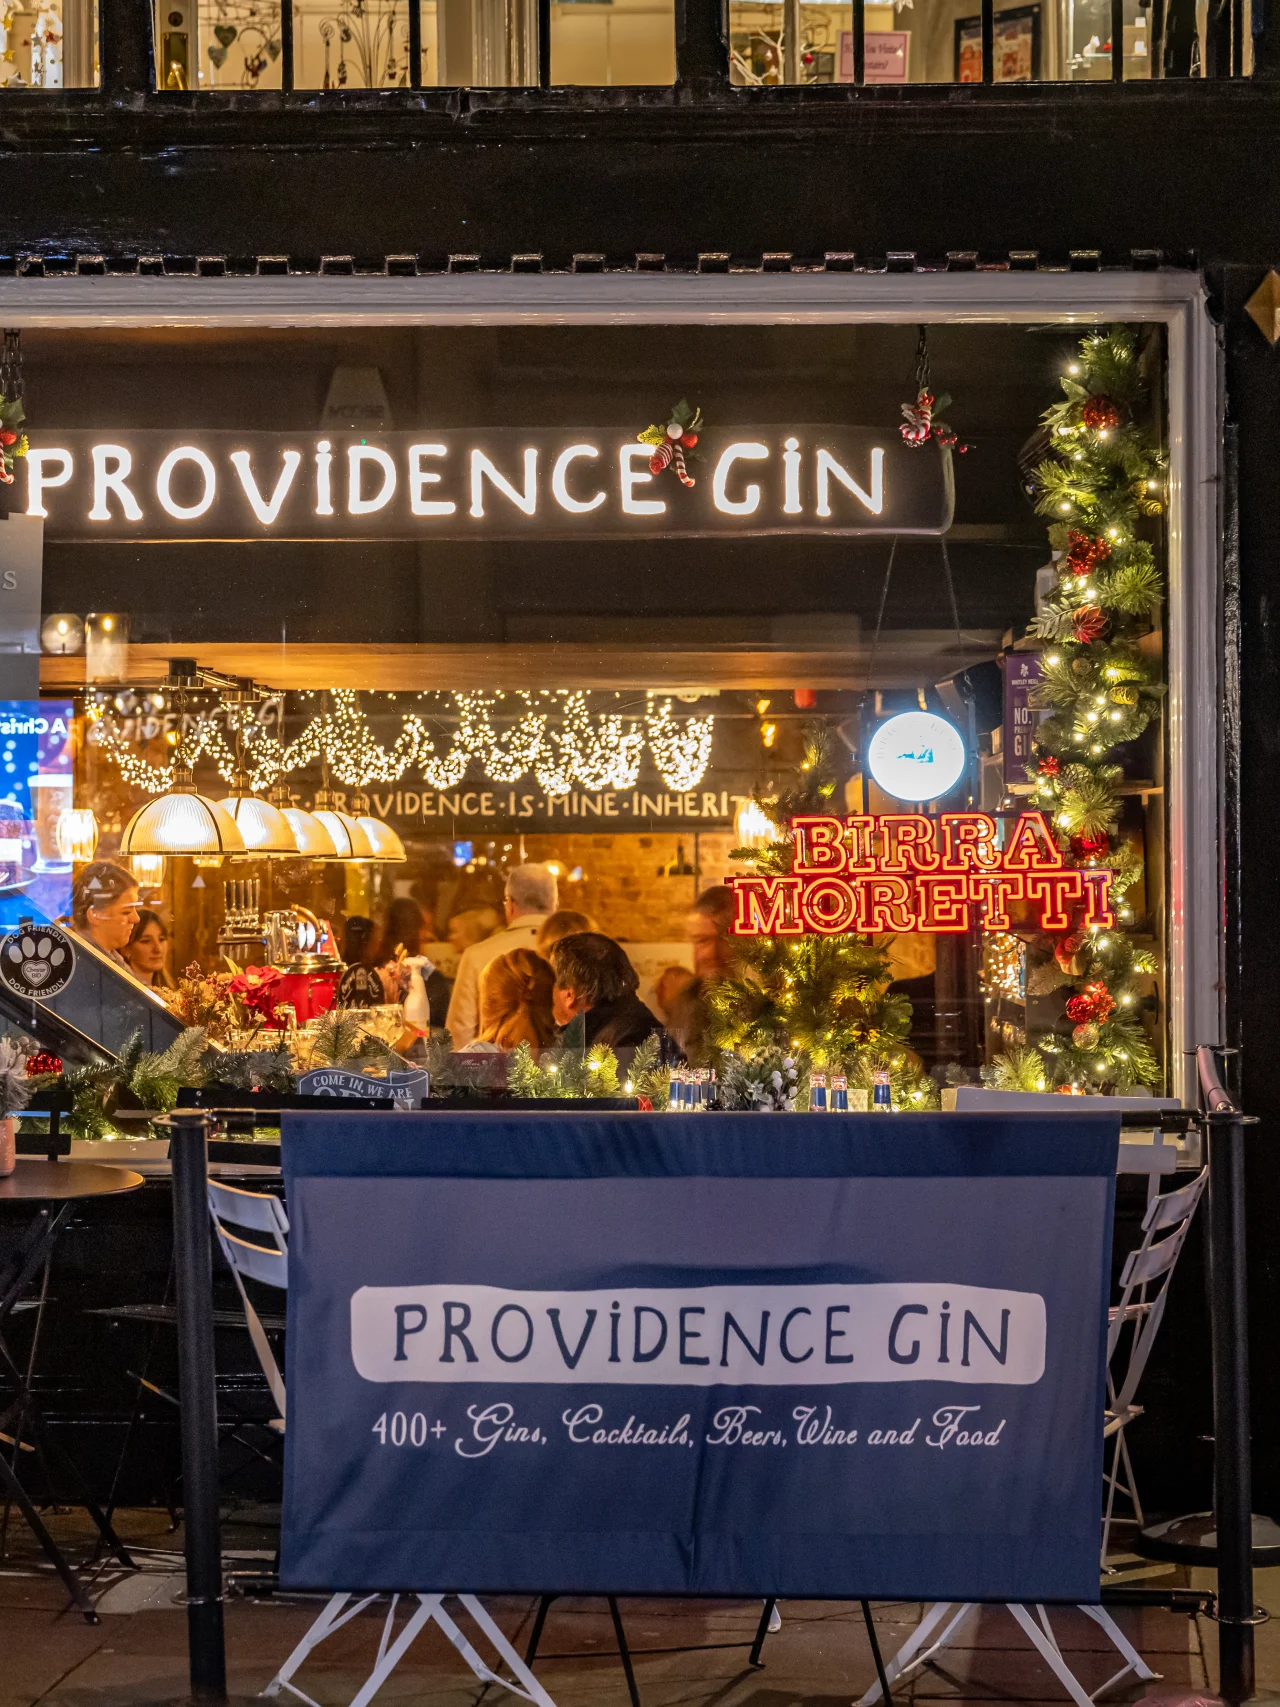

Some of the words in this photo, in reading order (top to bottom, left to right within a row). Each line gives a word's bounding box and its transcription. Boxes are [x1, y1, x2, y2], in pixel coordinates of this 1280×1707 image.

[1014, 735, 1027, 757] GI
[552, 793, 620, 817] MINE
[792, 812, 1064, 874] BIRRA
[733, 870, 1115, 934] MORETTI
[7, 928, 26, 944] DOG
[27, 925, 67, 944] FRIENDLY
[8, 977, 26, 994] DOG
[28, 977, 65, 997] FRIENDLY
[312, 1074, 346, 1087] COME
[349, 1077, 364, 1093] IN,
[367, 1084, 385, 1098] WE
[387, 1087, 413, 1099] ARE
[371, 1411, 447, 1447] 400+
[454, 1402, 548, 1459] Gins,
[562, 1403, 695, 1449] Cocktails,
[706, 1405, 788, 1449] Beers,
[792, 1405, 858, 1446] Wine
[867, 1418, 922, 1447] and
[925, 1405, 1007, 1450] Food
